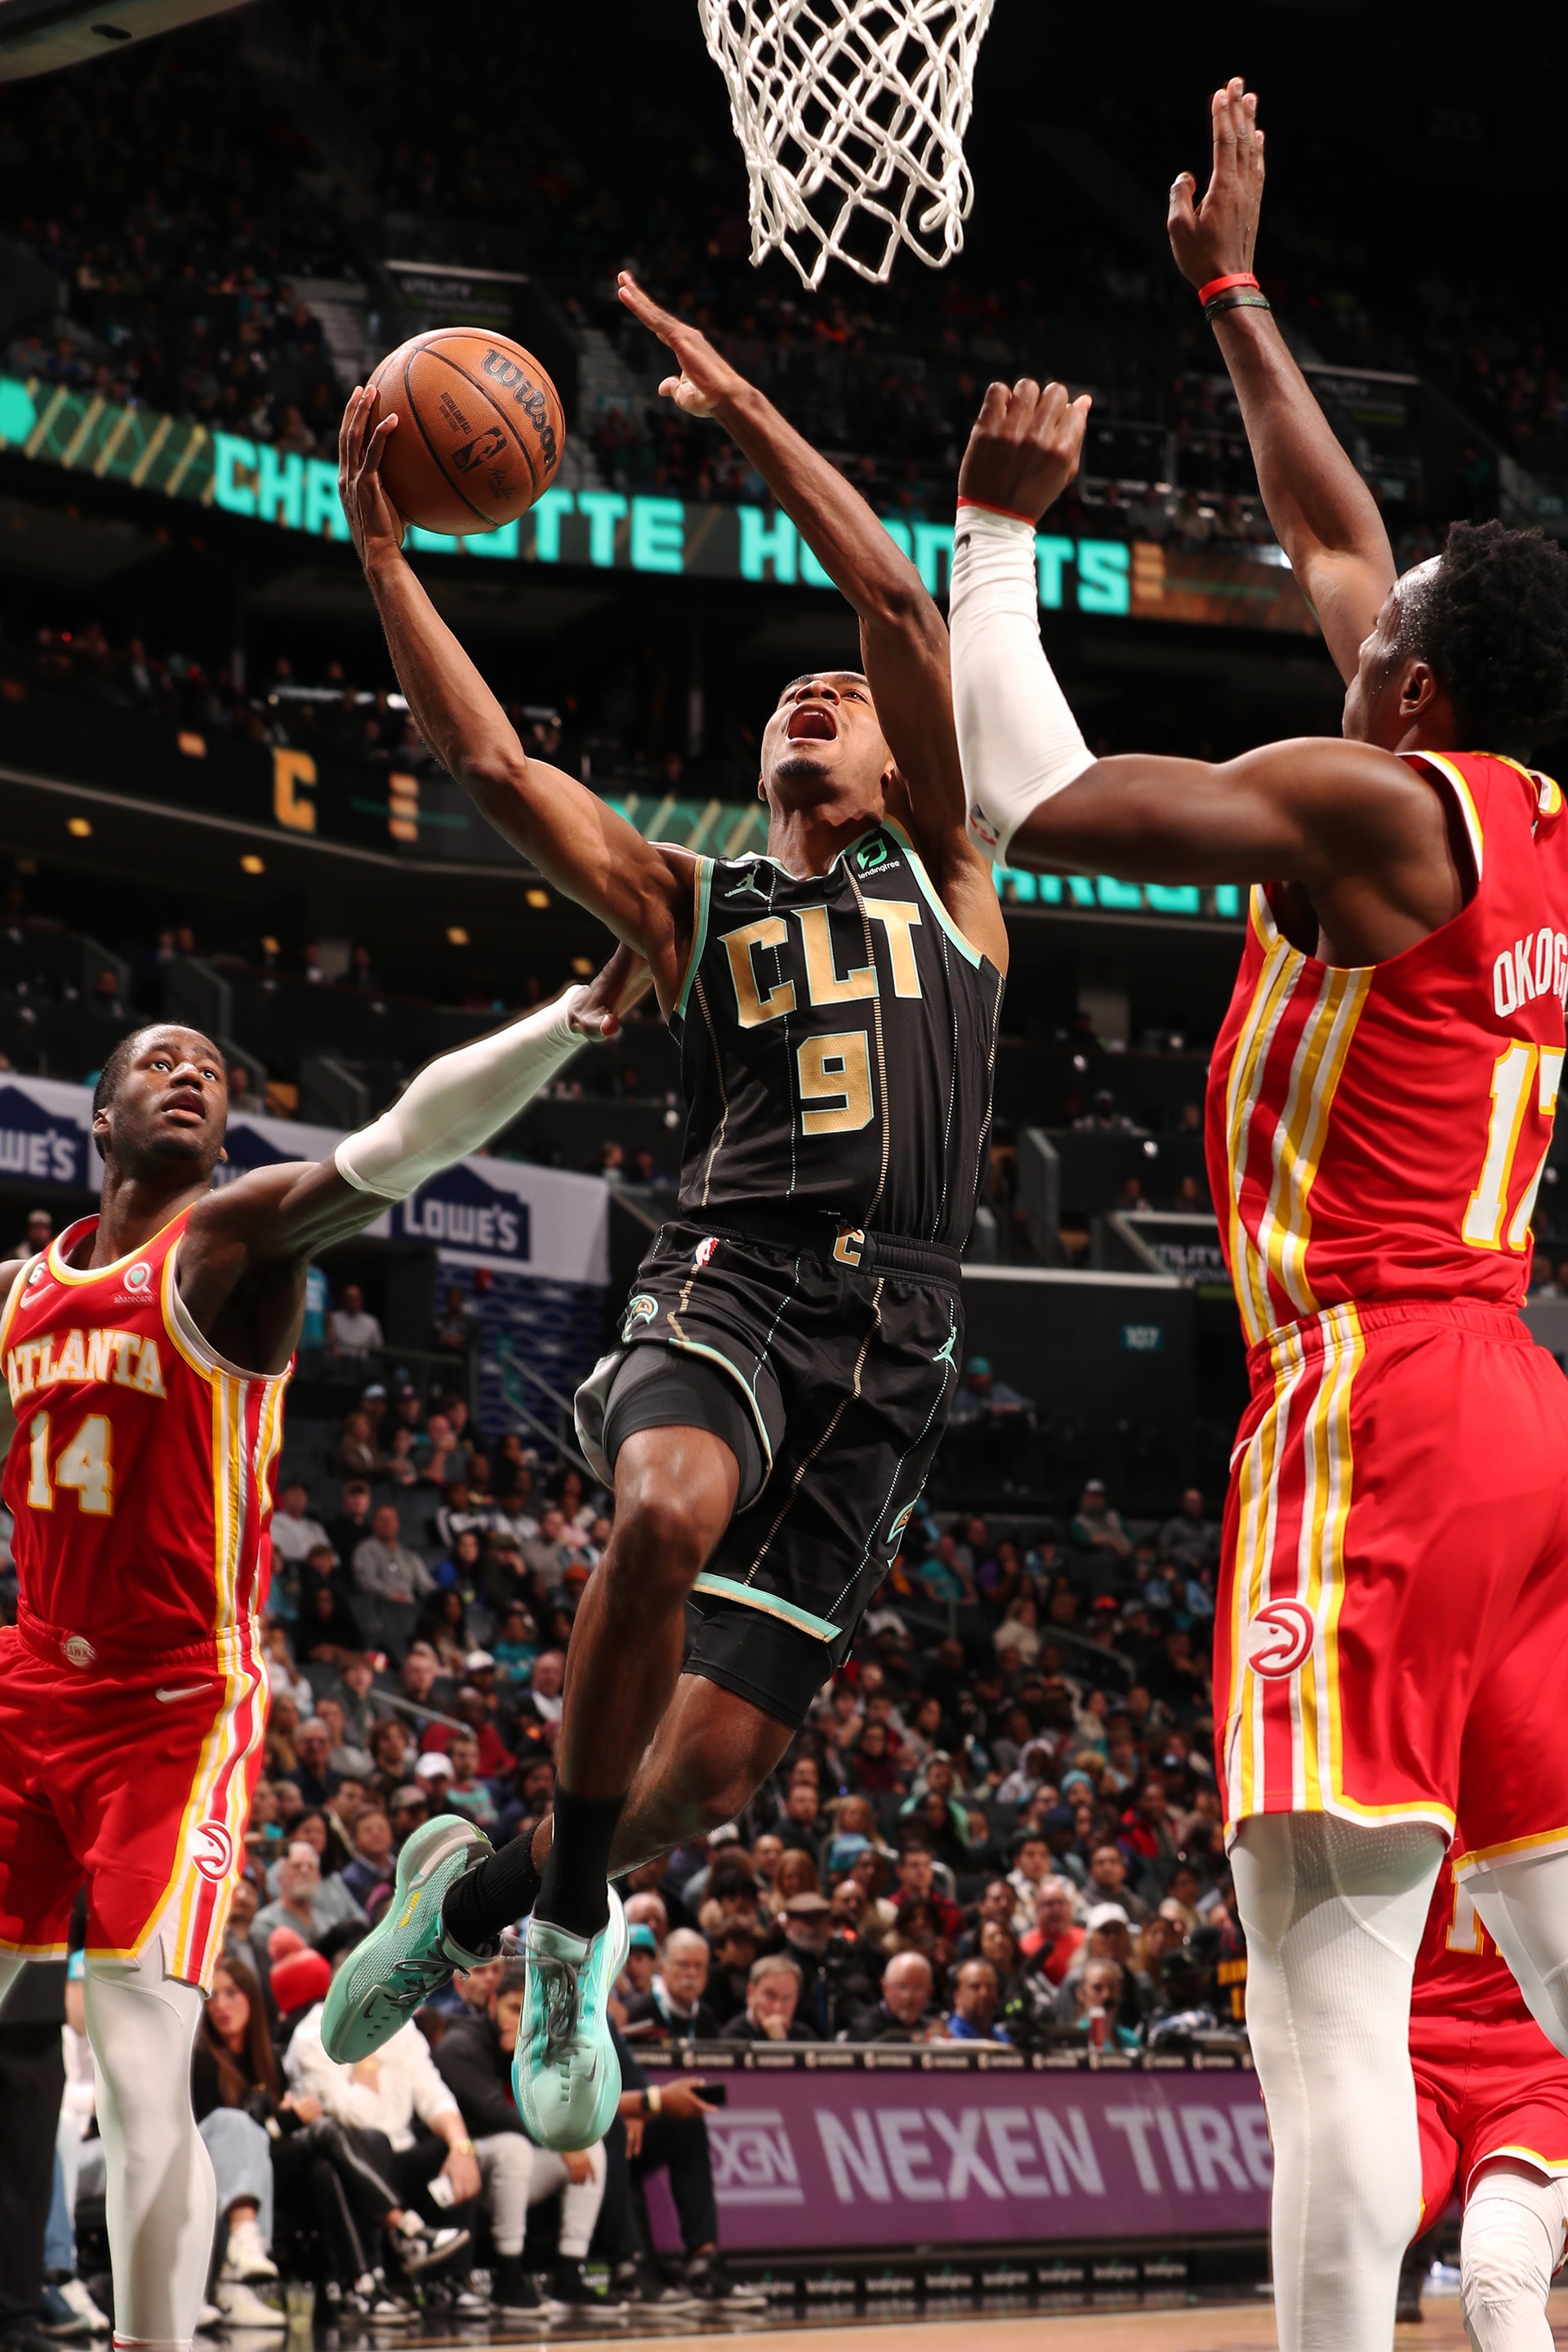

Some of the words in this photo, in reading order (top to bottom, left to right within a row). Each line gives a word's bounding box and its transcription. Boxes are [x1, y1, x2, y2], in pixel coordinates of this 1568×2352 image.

[481, 349, 558, 475] Wilson
[273, 745, 317, 833] C
[858, 860, 900, 880] lendingtree
[717, 896, 923, 1029] CLT
[796, 1030, 874, 1136] 9
[1461, 1038, 1566, 1252] 17
[403, 1193, 519, 1253] LOWE'S
[833, 1224, 866, 1267] C
[114, 1294, 153, 1303] sharecare
[7, 1329, 167, 1408] ATLANTA
[27, 1410, 115, 1517] 14
[814, 2105, 1105, 2203] NEXEN
[1103, 2104, 1274, 2196] TIRE
